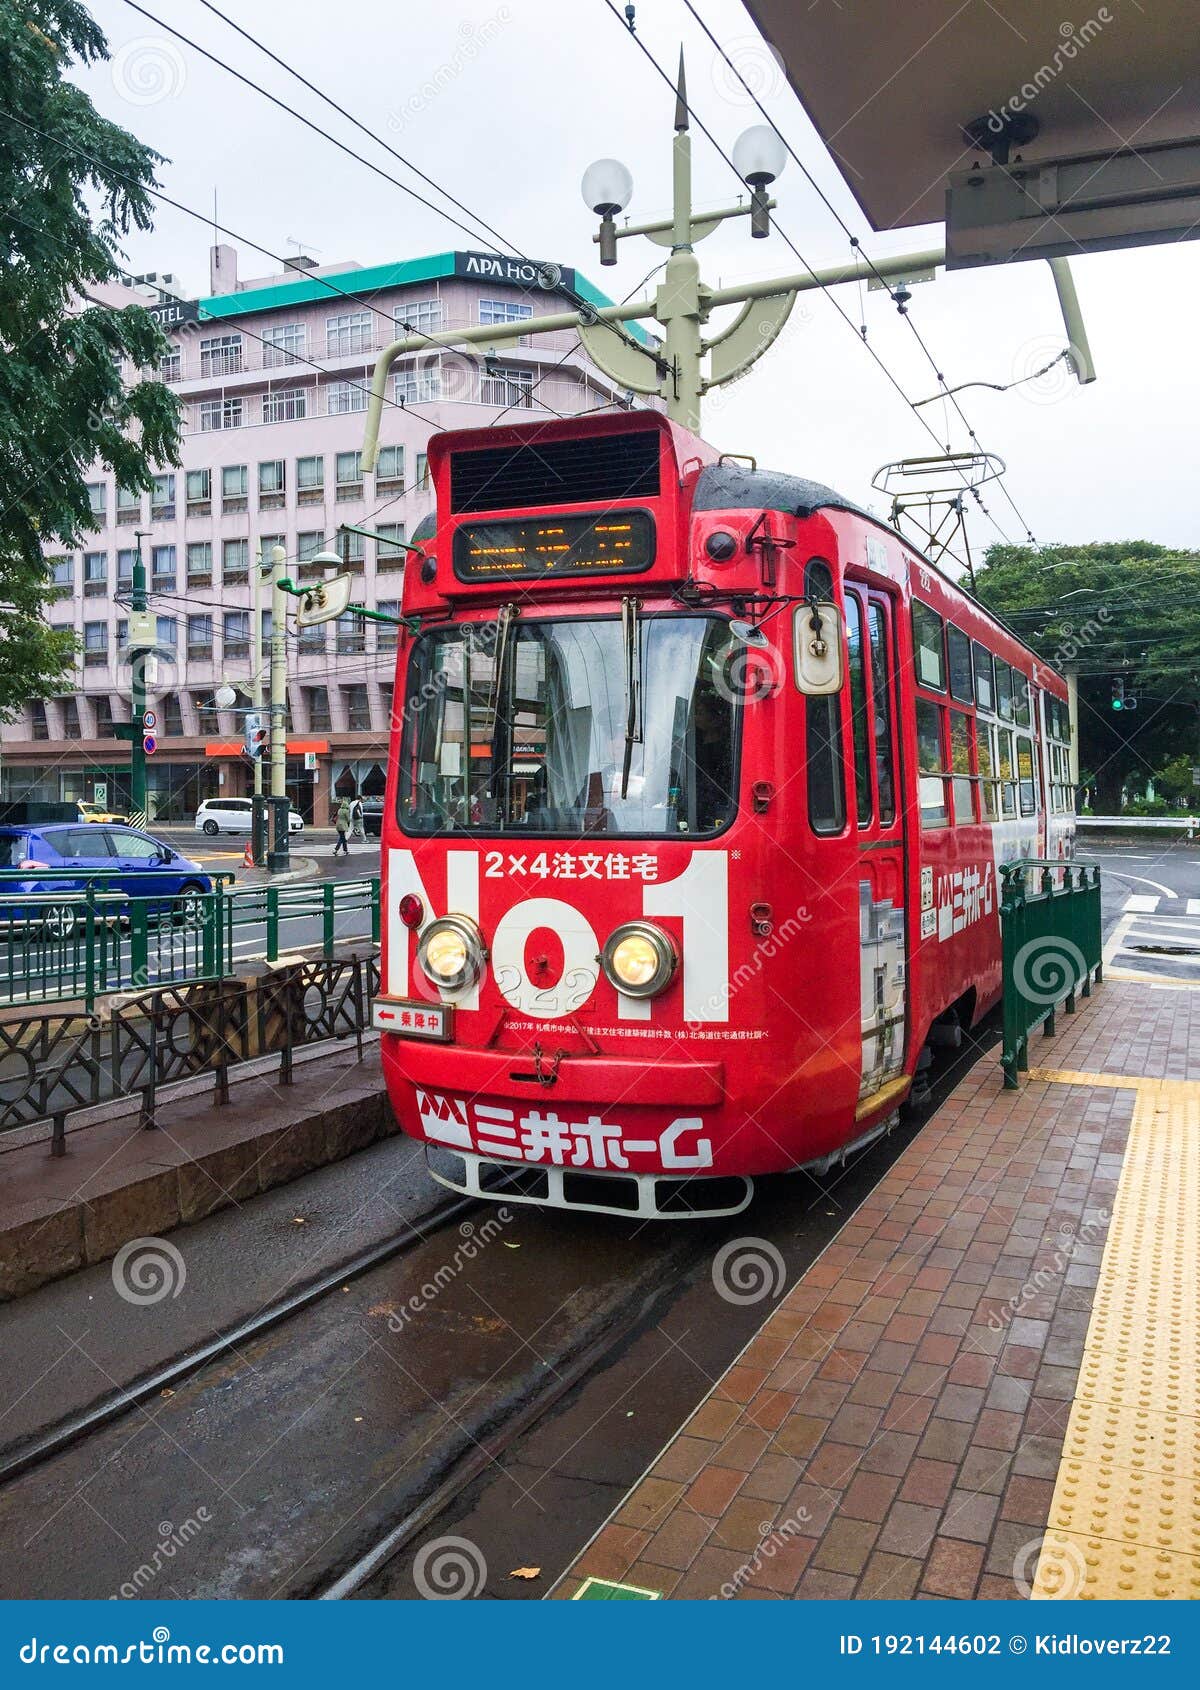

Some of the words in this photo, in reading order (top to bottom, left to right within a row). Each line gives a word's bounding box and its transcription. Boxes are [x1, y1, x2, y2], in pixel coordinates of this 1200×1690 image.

[466, 257, 503, 277] APA
[149, 306, 185, 325] OTEL
[146, 715, 154, 726] 40
[400, 1010, 440, 1031] 乗降中
[473, 1103, 714, 1169] 三井ホーム
